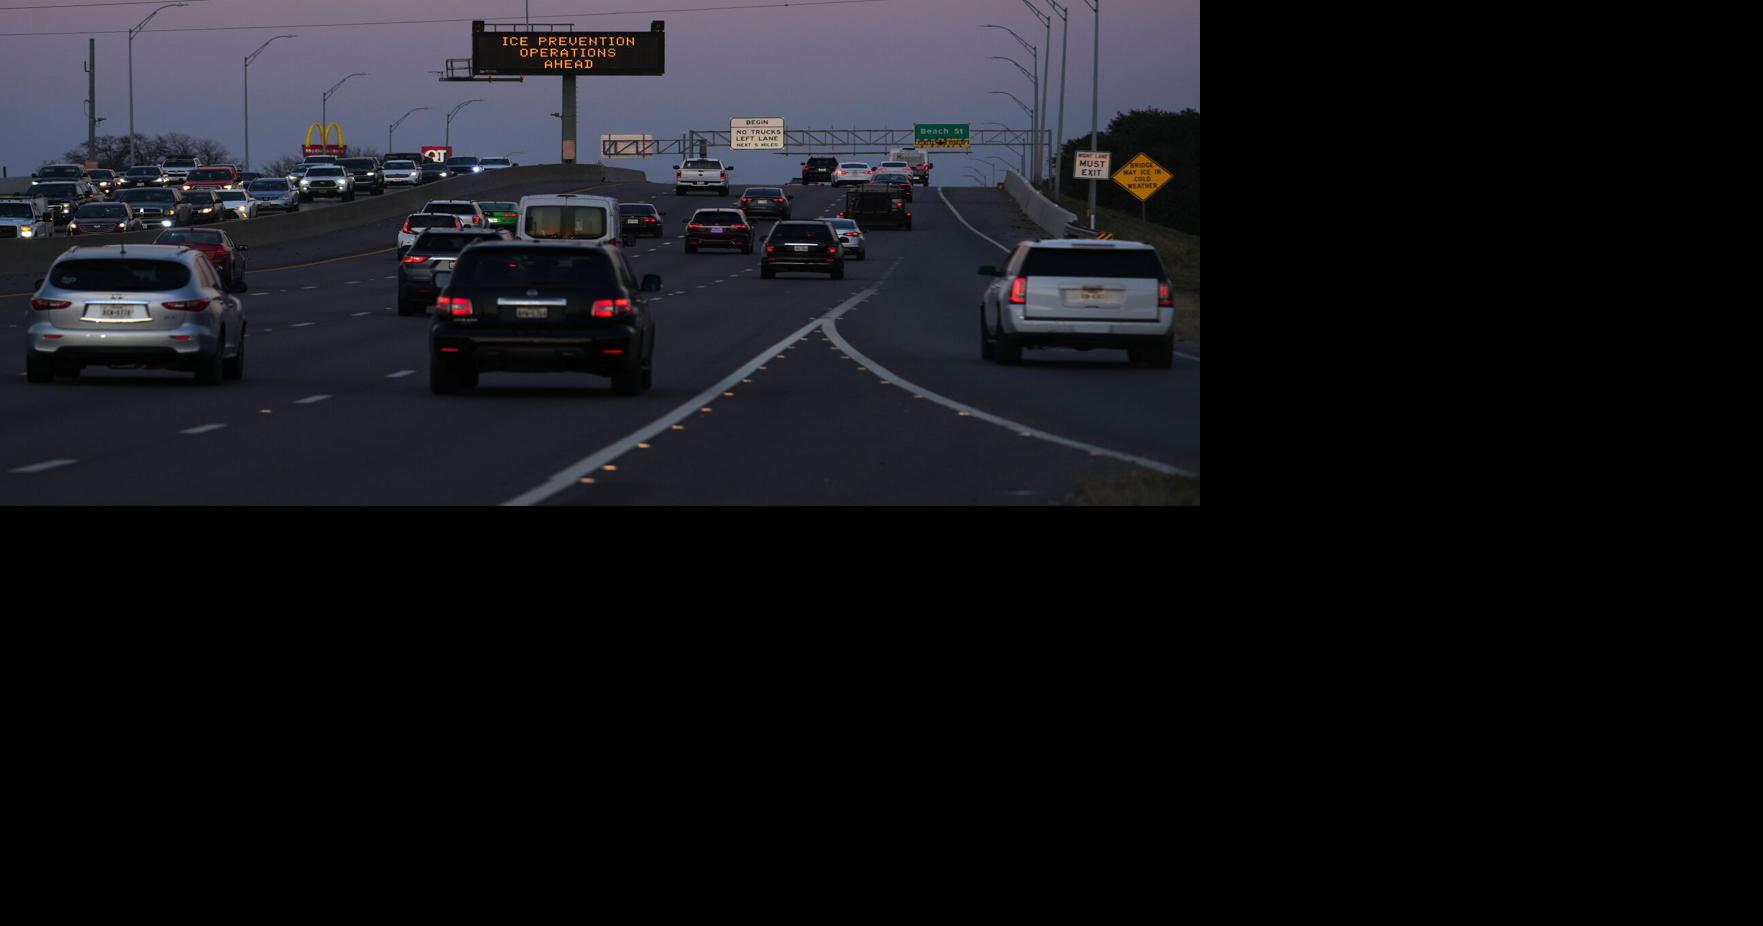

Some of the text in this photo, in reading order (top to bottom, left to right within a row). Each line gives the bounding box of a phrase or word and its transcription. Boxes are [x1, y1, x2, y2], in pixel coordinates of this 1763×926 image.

[502, 36, 635, 46] ICE PREVENTION
[519, 48, 616, 57] OPERATIONS
[544, 59, 593, 69] AHEAD
[424, 149, 448, 162] QT
[1079, 160, 1105, 168] MUST
